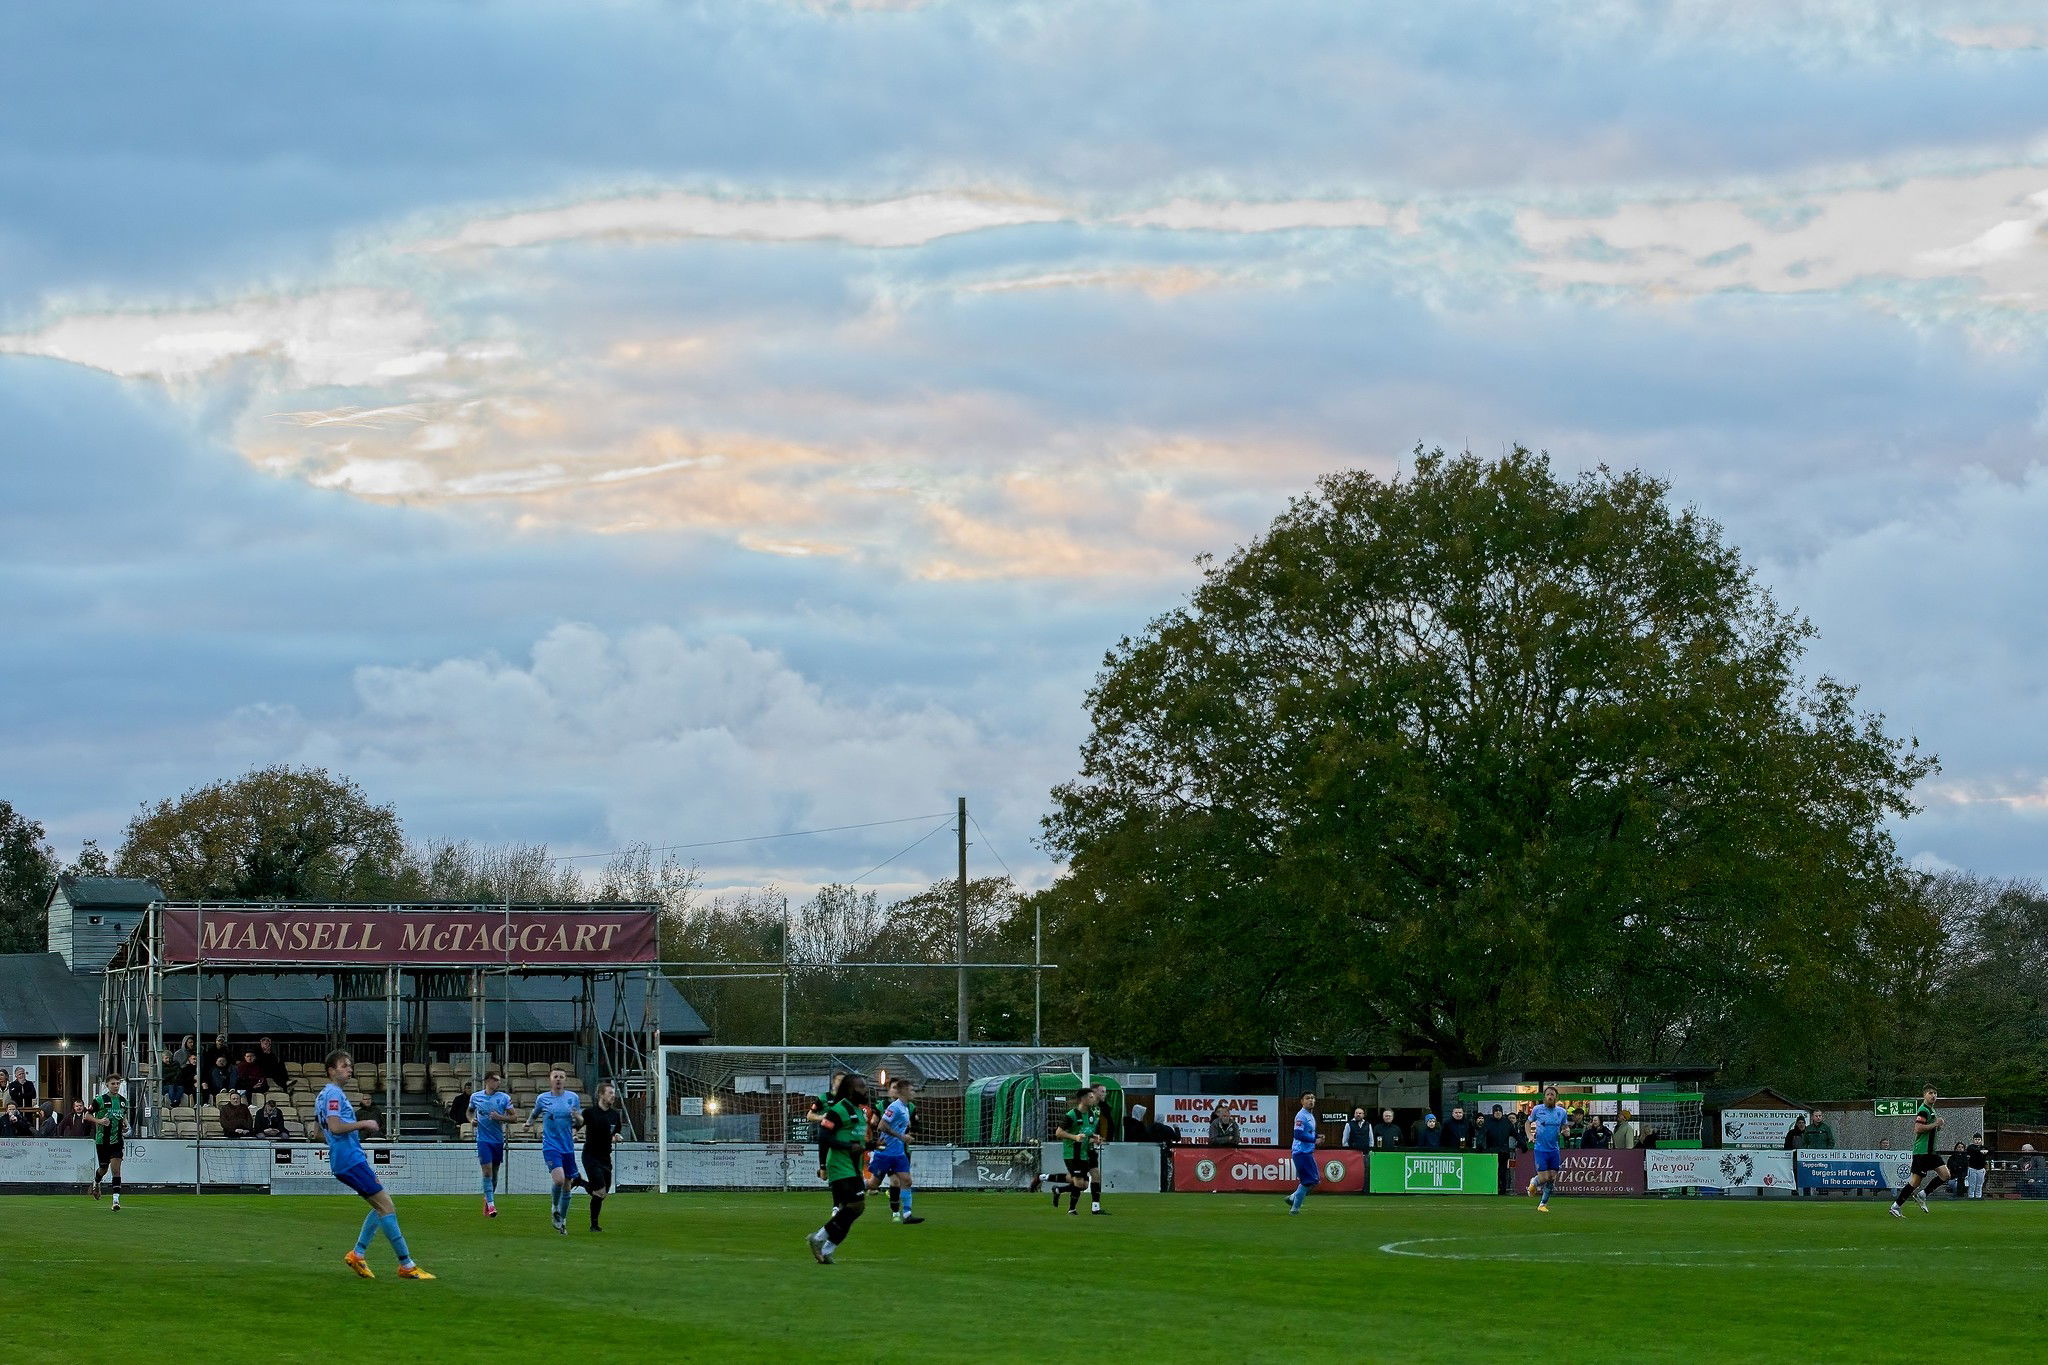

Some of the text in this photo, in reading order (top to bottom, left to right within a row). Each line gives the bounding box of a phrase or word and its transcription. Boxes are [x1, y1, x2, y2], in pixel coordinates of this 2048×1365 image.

[201, 922, 622, 952] MANSELL McTAGGART
[1175, 1099, 1258, 1111] MICK CAVE
[1167, 1115, 1189, 1123] MRL
[1192, 1115, 1211, 1123] Gra
[1250, 1115, 1266, 1123] Ltd
[125, 1141, 146, 1158] ite
[1559, 1157, 1614, 1169] ANSELL
[1800, 1152, 1828, 1160] Burgess
[1875, 1153, 1898, 1161] Rotary
[977, 1166, 1013, 1181] Real
[1231, 1158, 1300, 1181] o'neill
[1413, 1160, 1455, 1174] PITCHING
[1651, 1162, 1695, 1173] Are you?
[1433, 1173, 1443, 1187] IN
[1842, 1178, 1879, 1186] community
